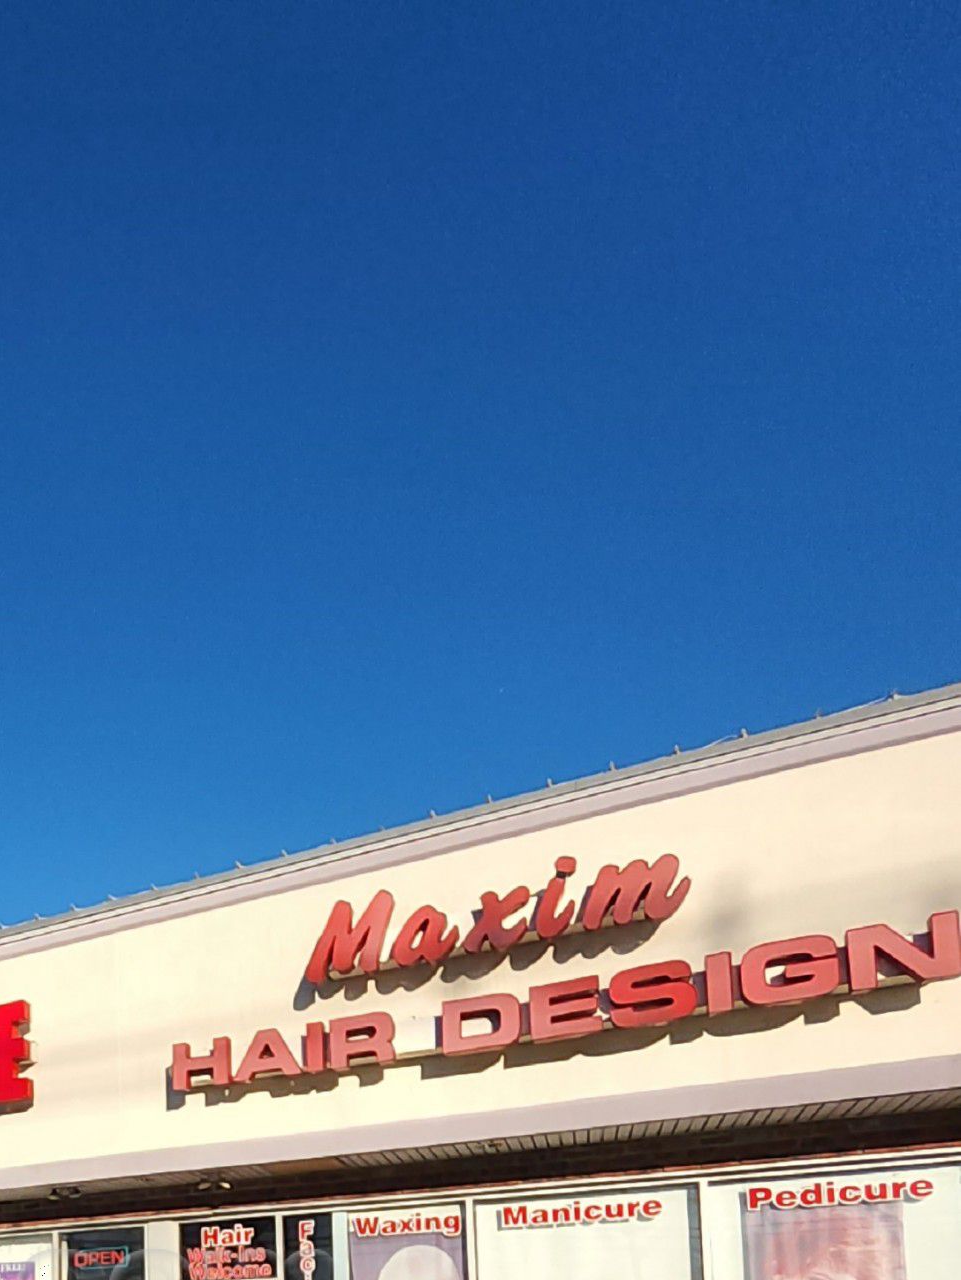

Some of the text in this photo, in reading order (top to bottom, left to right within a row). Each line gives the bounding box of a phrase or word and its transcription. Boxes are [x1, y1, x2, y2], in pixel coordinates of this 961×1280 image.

[304, 853, 691, 986] Maxim
[171, 909, 961, 1092] HAIR DESIGN
[746, 1175, 935, 1212] Pedicure
[352, 1212, 462, 1238] Waxing
[500, 1197, 664, 1229] Manicure
[200, 1223, 255, 1247] Hair
[73, 1250, 126, 1269] OPEN
[188, 1262, 272, 1280] Welcome
